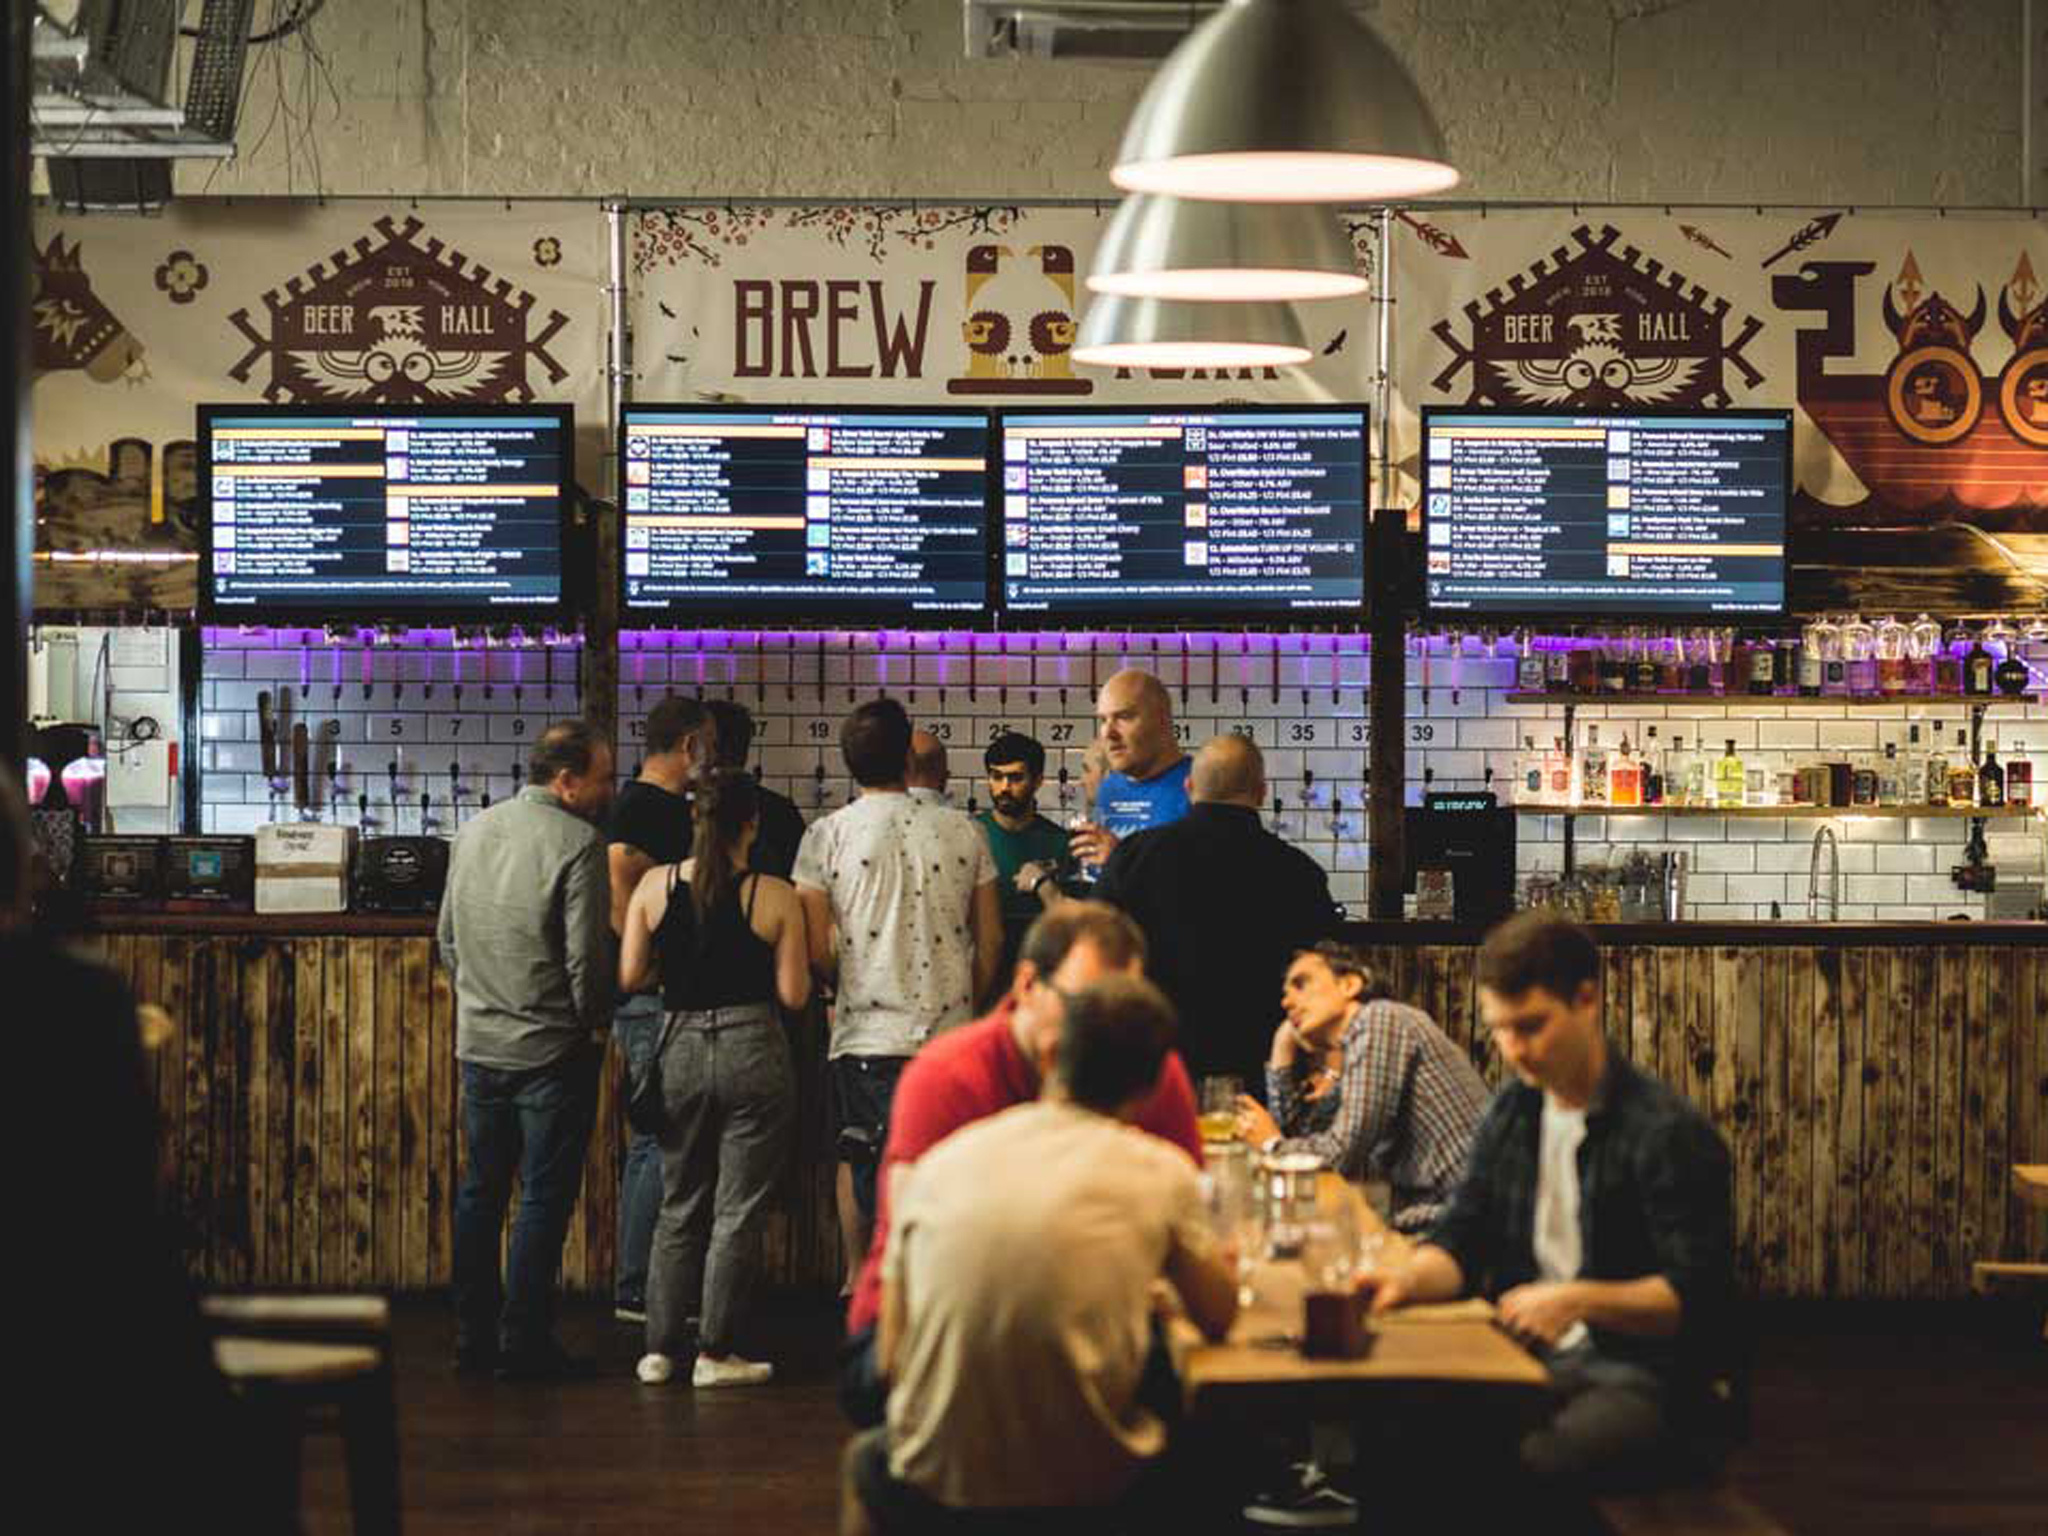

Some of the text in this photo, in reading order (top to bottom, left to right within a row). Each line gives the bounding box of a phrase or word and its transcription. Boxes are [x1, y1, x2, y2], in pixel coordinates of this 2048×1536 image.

[304, 305, 495, 334] BEER HALL
[1504, 312, 1691, 343] BEER HALL
[733, 280, 936, 378] BREW
[328, 719, 341, 735] 3
[391, 719, 403, 736] 5
[450, 719, 462, 736] 7
[513, 719, 525, 736] 9
[808, 721, 829, 739] 19
[928, 723, 952, 739] 23
[1051, 724, 1075, 741] 27
[1292, 725, 1315, 741] 35
[1352, 725, 1371, 741] 37
[1412, 724, 1434, 741] 39
